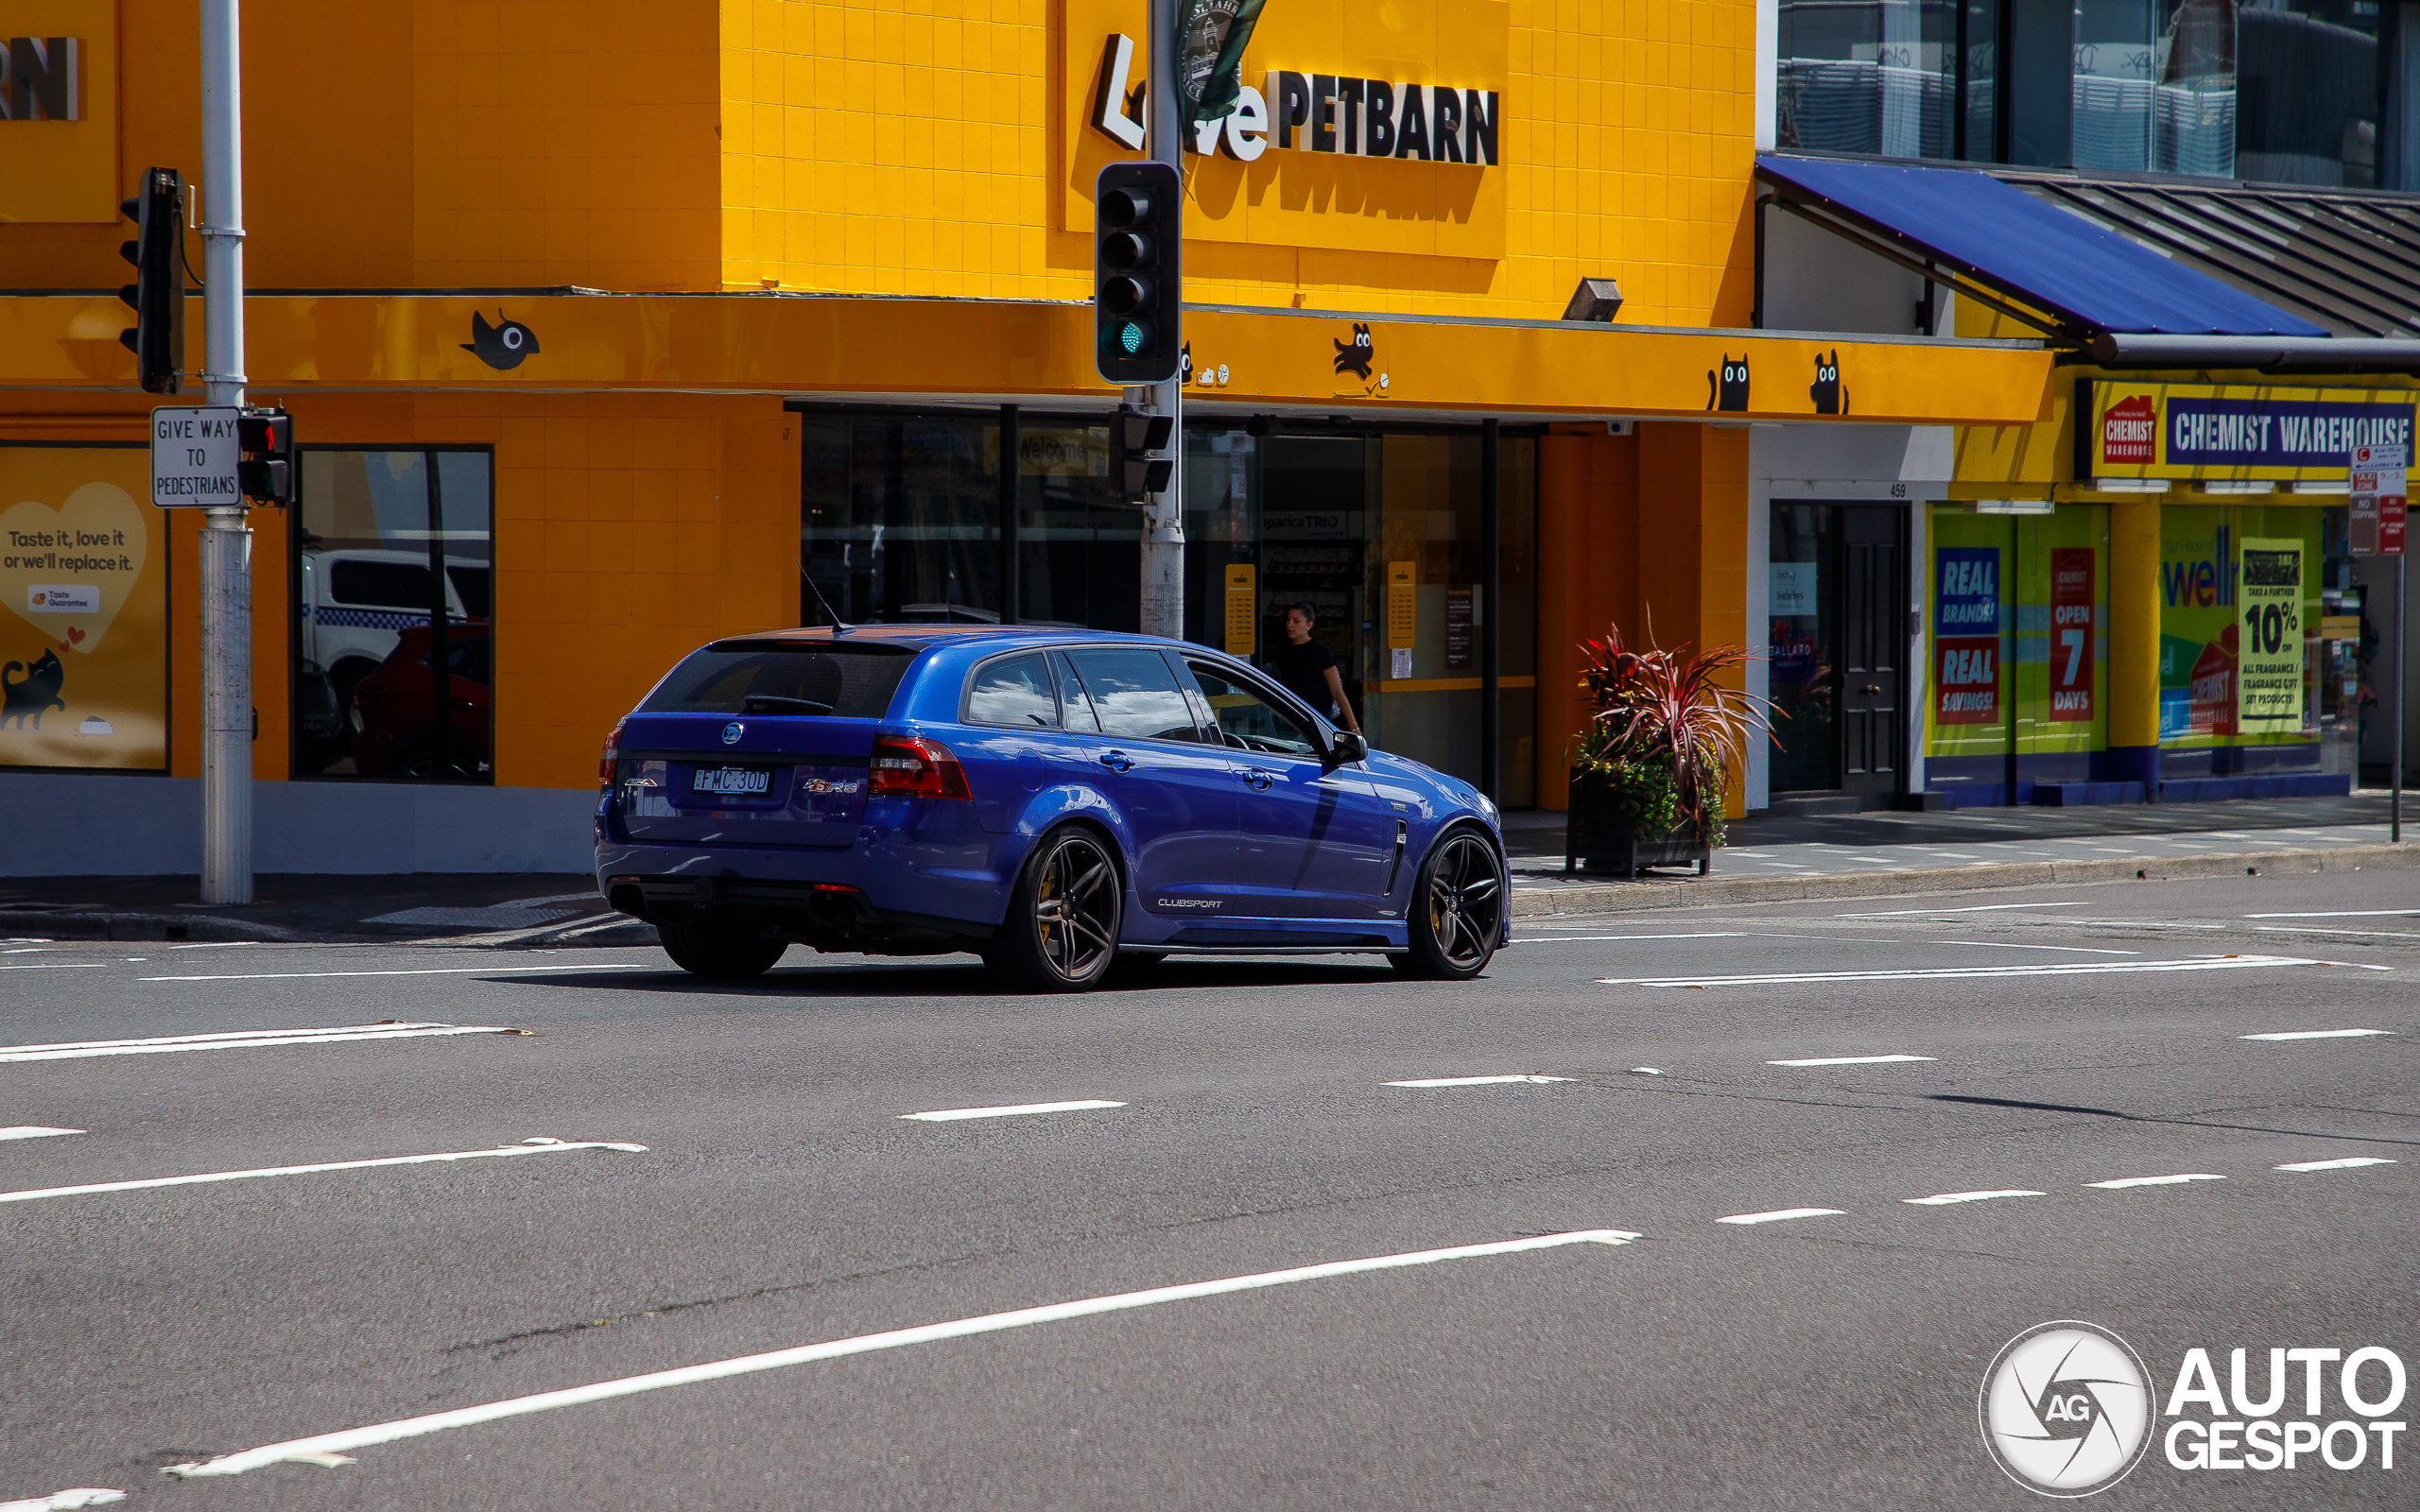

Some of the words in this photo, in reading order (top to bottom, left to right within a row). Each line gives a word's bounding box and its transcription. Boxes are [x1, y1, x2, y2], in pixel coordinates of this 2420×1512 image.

[1268, 70, 1500, 166] PETBARN
[157, 420, 194, 438] GIVE
[200, 420, 234, 438] WAY
[2106, 420, 2153, 442] CHEMIST
[2175, 412, 2272, 453] CHEMIST
[2279, 415, 2411, 454] WAREHOUSE
[186, 449, 206, 467] TO
[2106, 444, 2152, 456] WAREHOUSE
[157, 476, 235, 495] PEDESTRIANS
[1890, 483, 1906, 498] 459
[2358, 499, 2371, 509] NO
[8, 531, 53, 548] Taste
[57, 530, 74, 550] it,
[77, 531, 110, 549] love
[113, 530, 125, 547] it
[4, 555, 23, 568] or
[22, 554, 56, 569] we'll
[59, 555, 116, 574] replace
[118, 556, 134, 572] it.
[1943, 560, 1995, 596] REAL
[48, 591, 70, 599] Taste
[2248, 587, 2264, 597] TAKE
[48, 598, 89, 608] Guarantee
[1943, 603, 1995, 624] BRANDS!
[2055, 605, 2090, 625] OPEN
[1769, 644, 1811, 657] BALLARD
[2061, 628, 2084, 686] 7
[1943, 649, 1994, 685] REAL
[2242, 663, 2255, 674] ALL
[2256, 663, 2295, 674] FRAGRANCE
[2192, 669, 2230, 704] CHEMIST
[2243, 679, 2283, 689] FRAGRANCE
[1942, 691, 1994, 713] SAVINGS!
[2053, 691, 2089, 711] DAYS
[2245, 694, 2257, 705] SET
[1157, 898, 1223, 912] CLUBSPORT
